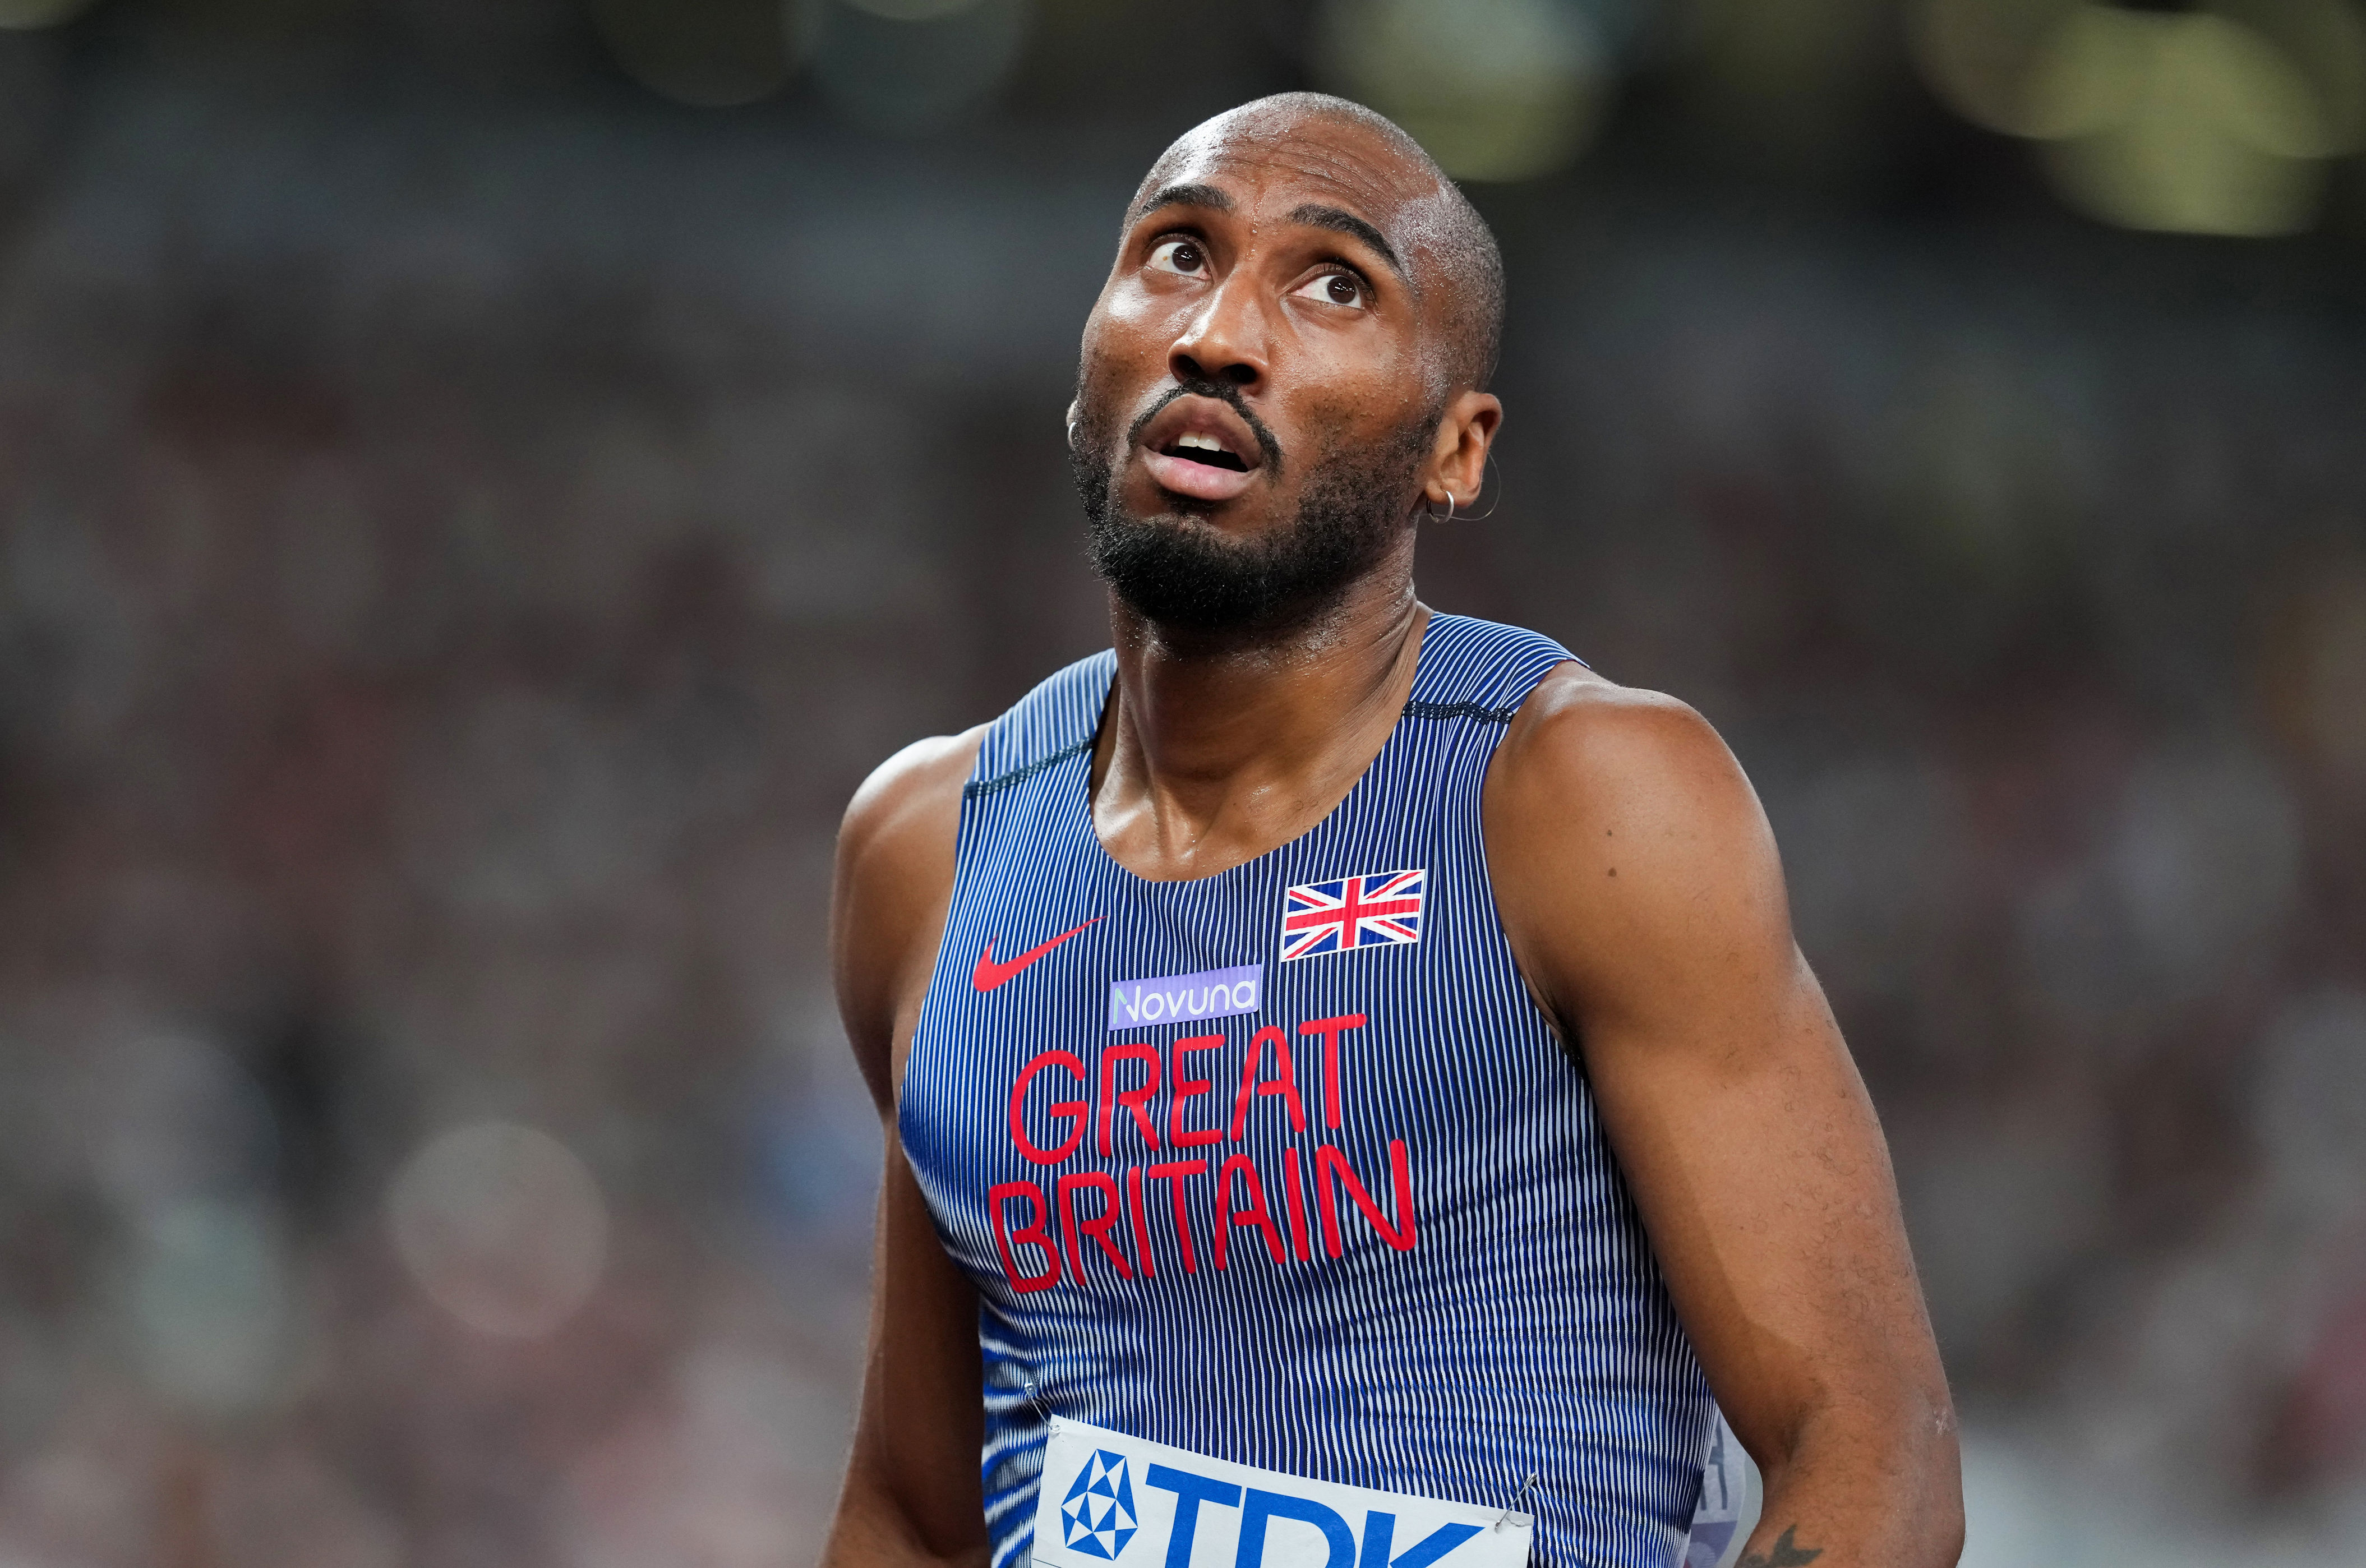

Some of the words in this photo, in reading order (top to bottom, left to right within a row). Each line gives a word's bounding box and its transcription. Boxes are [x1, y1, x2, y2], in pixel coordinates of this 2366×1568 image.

[1113, 980, 1256, 1025] Novuna
[1010, 1013, 1367, 1165] GREAT
[989, 1139, 1417, 1293] BRITAIN
